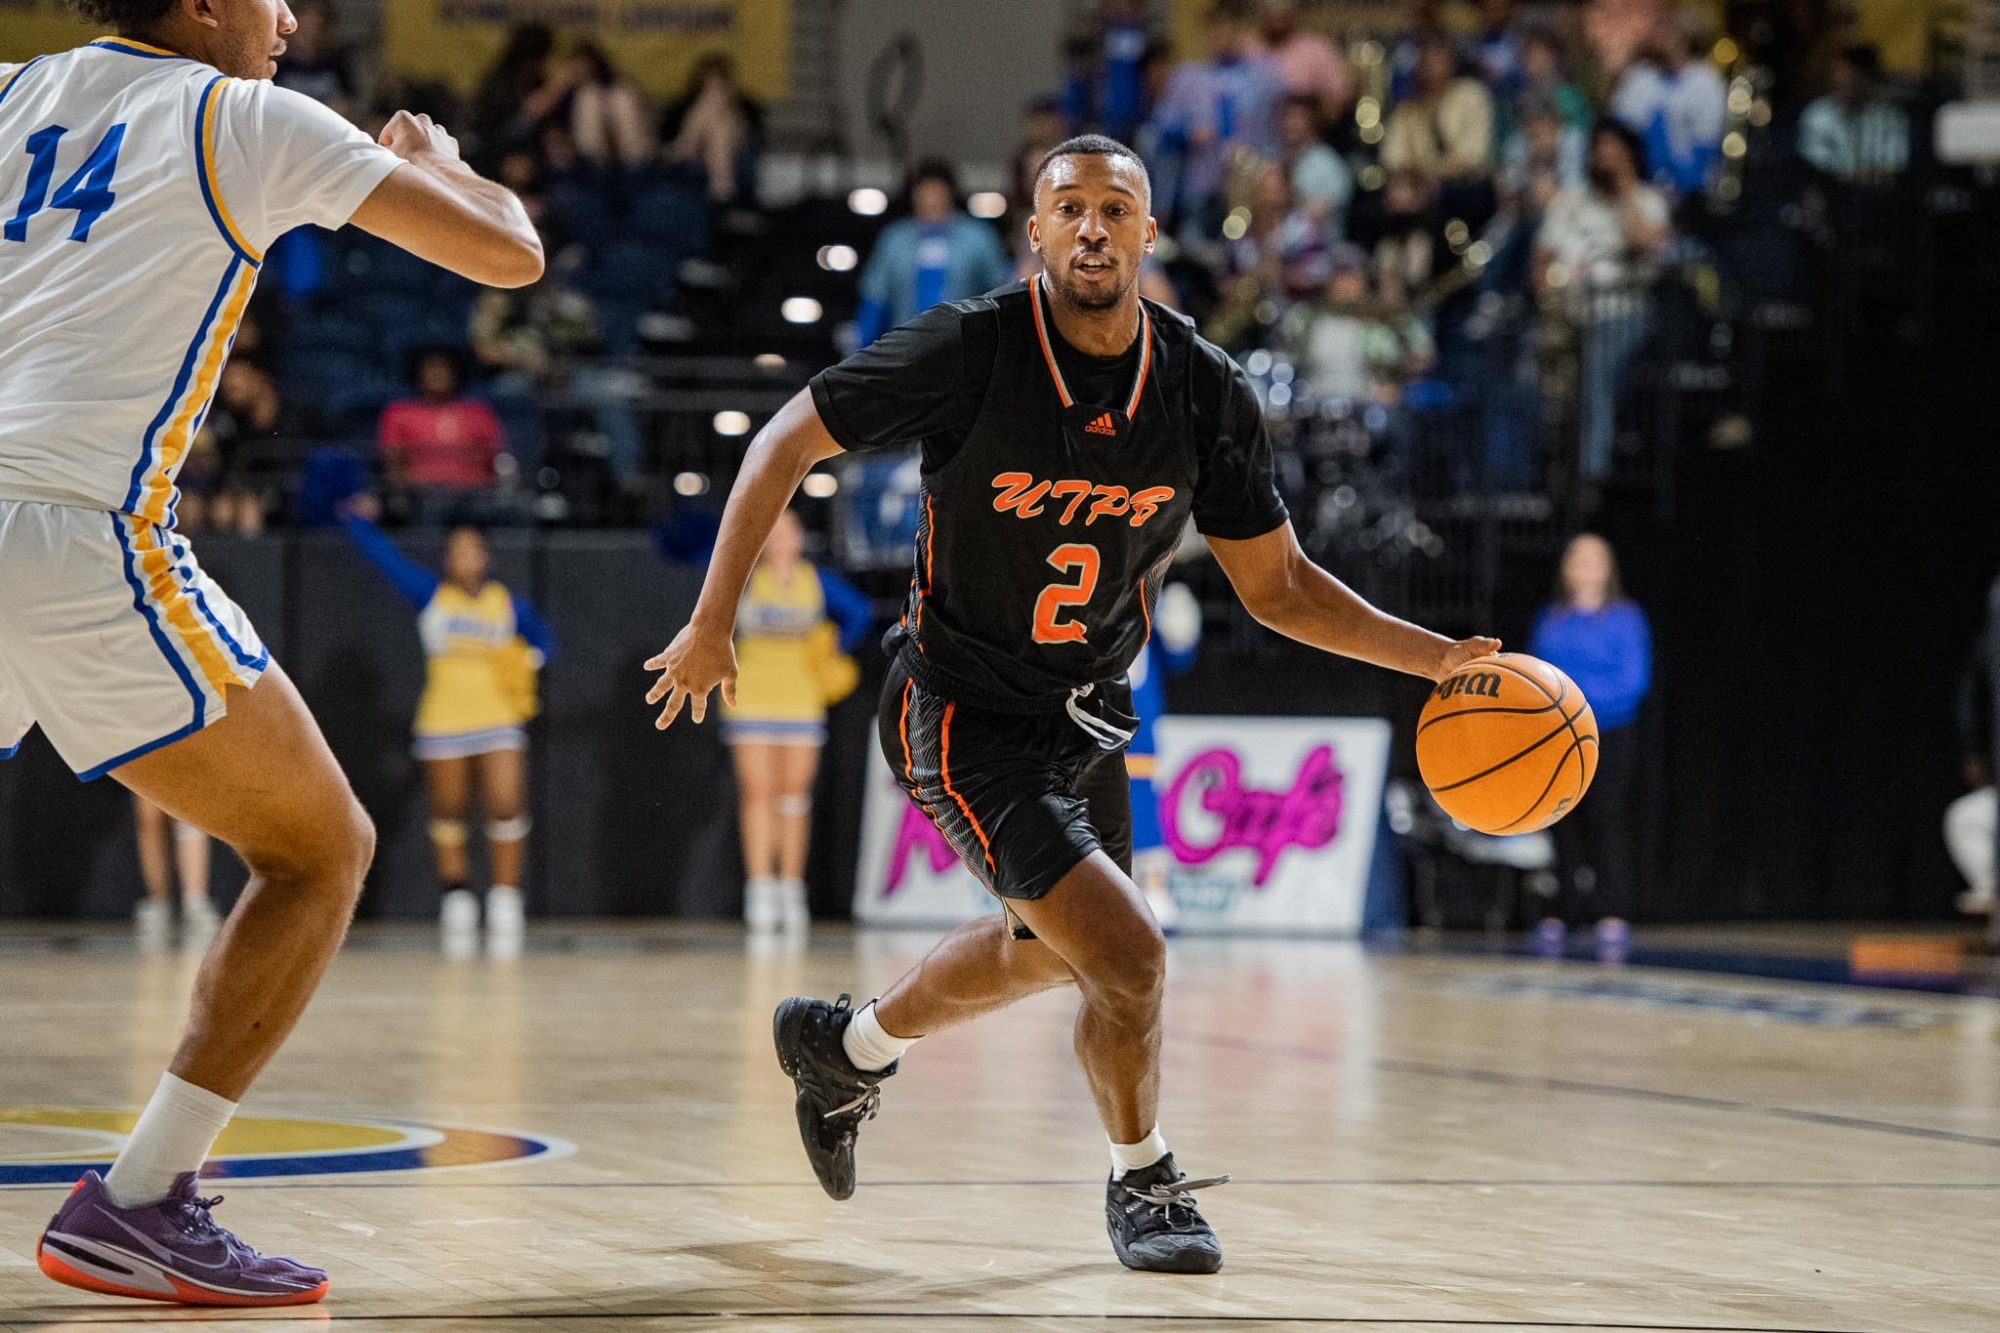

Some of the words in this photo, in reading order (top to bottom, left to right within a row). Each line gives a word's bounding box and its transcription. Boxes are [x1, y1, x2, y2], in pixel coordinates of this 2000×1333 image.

[3, 122, 127, 243] 14
[1085, 425, 1116, 436] adidas
[991, 471, 1175, 527] UTPB
[1031, 543, 1101, 644] 2
